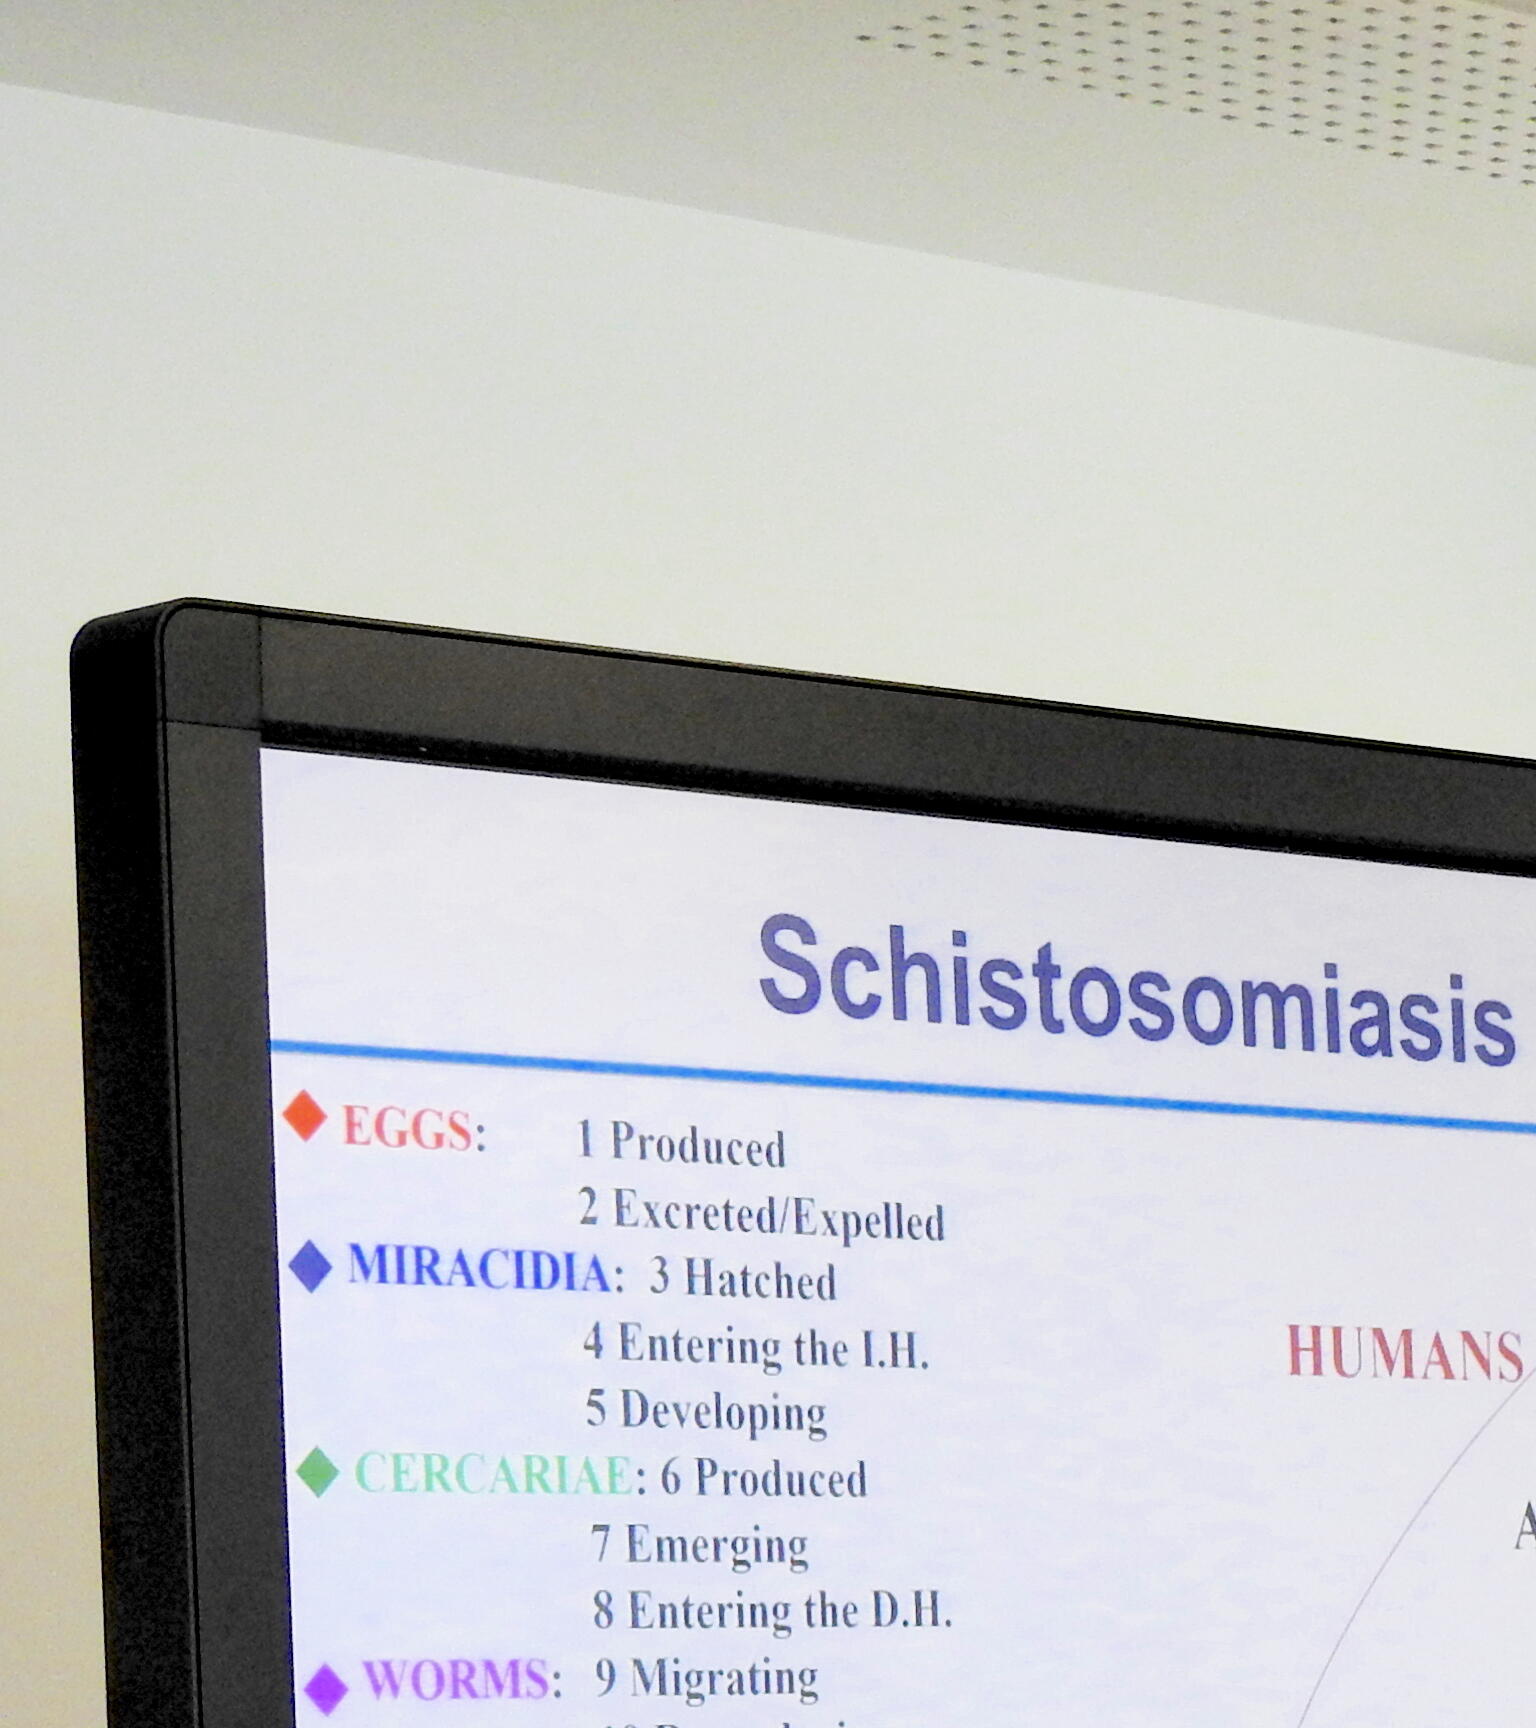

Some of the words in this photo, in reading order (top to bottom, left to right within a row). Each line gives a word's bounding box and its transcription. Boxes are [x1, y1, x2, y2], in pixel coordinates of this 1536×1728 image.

[758, 912, 1517, 1068] Schistosomiasis
[341, 1106, 486, 1152] EGGS:
[579, 1120, 592, 1158] 1
[611, 1121, 786, 1168] Produced
[578, 1186, 598, 1226] 2
[613, 1189, 945, 1248] Excreted/Expelled
[348, 1242, 624, 1294] MIRACIDIA:
[649, 1256, 669, 1295] 3
[684, 1258, 836, 1300] Hatched
[583, 1322, 603, 1359] 4
[619, 1322, 782, 1376] Entering
[794, 1330, 849, 1368] the
[862, 1331, 929, 1369] I.H.
[1288, 1324, 1524, 1382] HUMANS
[586, 1389, 606, 1427] 5
[622, 1390, 827, 1441] Developing
[354, 1451, 646, 1495] CERCARIAE:
[661, 1458, 681, 1496] 6
[696, 1458, 868, 1498] Produced
[591, 1525, 611, 1562] 7
[626, 1524, 808, 1573] Emerging
[594, 1591, 613, 1628] 8
[629, 1590, 791, 1638] Entering
[804, 1590, 859, 1628] the
[872, 1591, 952, 1628] D.H.
[362, 1659, 562, 1700] WORMS:
[596, 1659, 616, 1697] 9
[631, 1658, 818, 1707] Migrating
